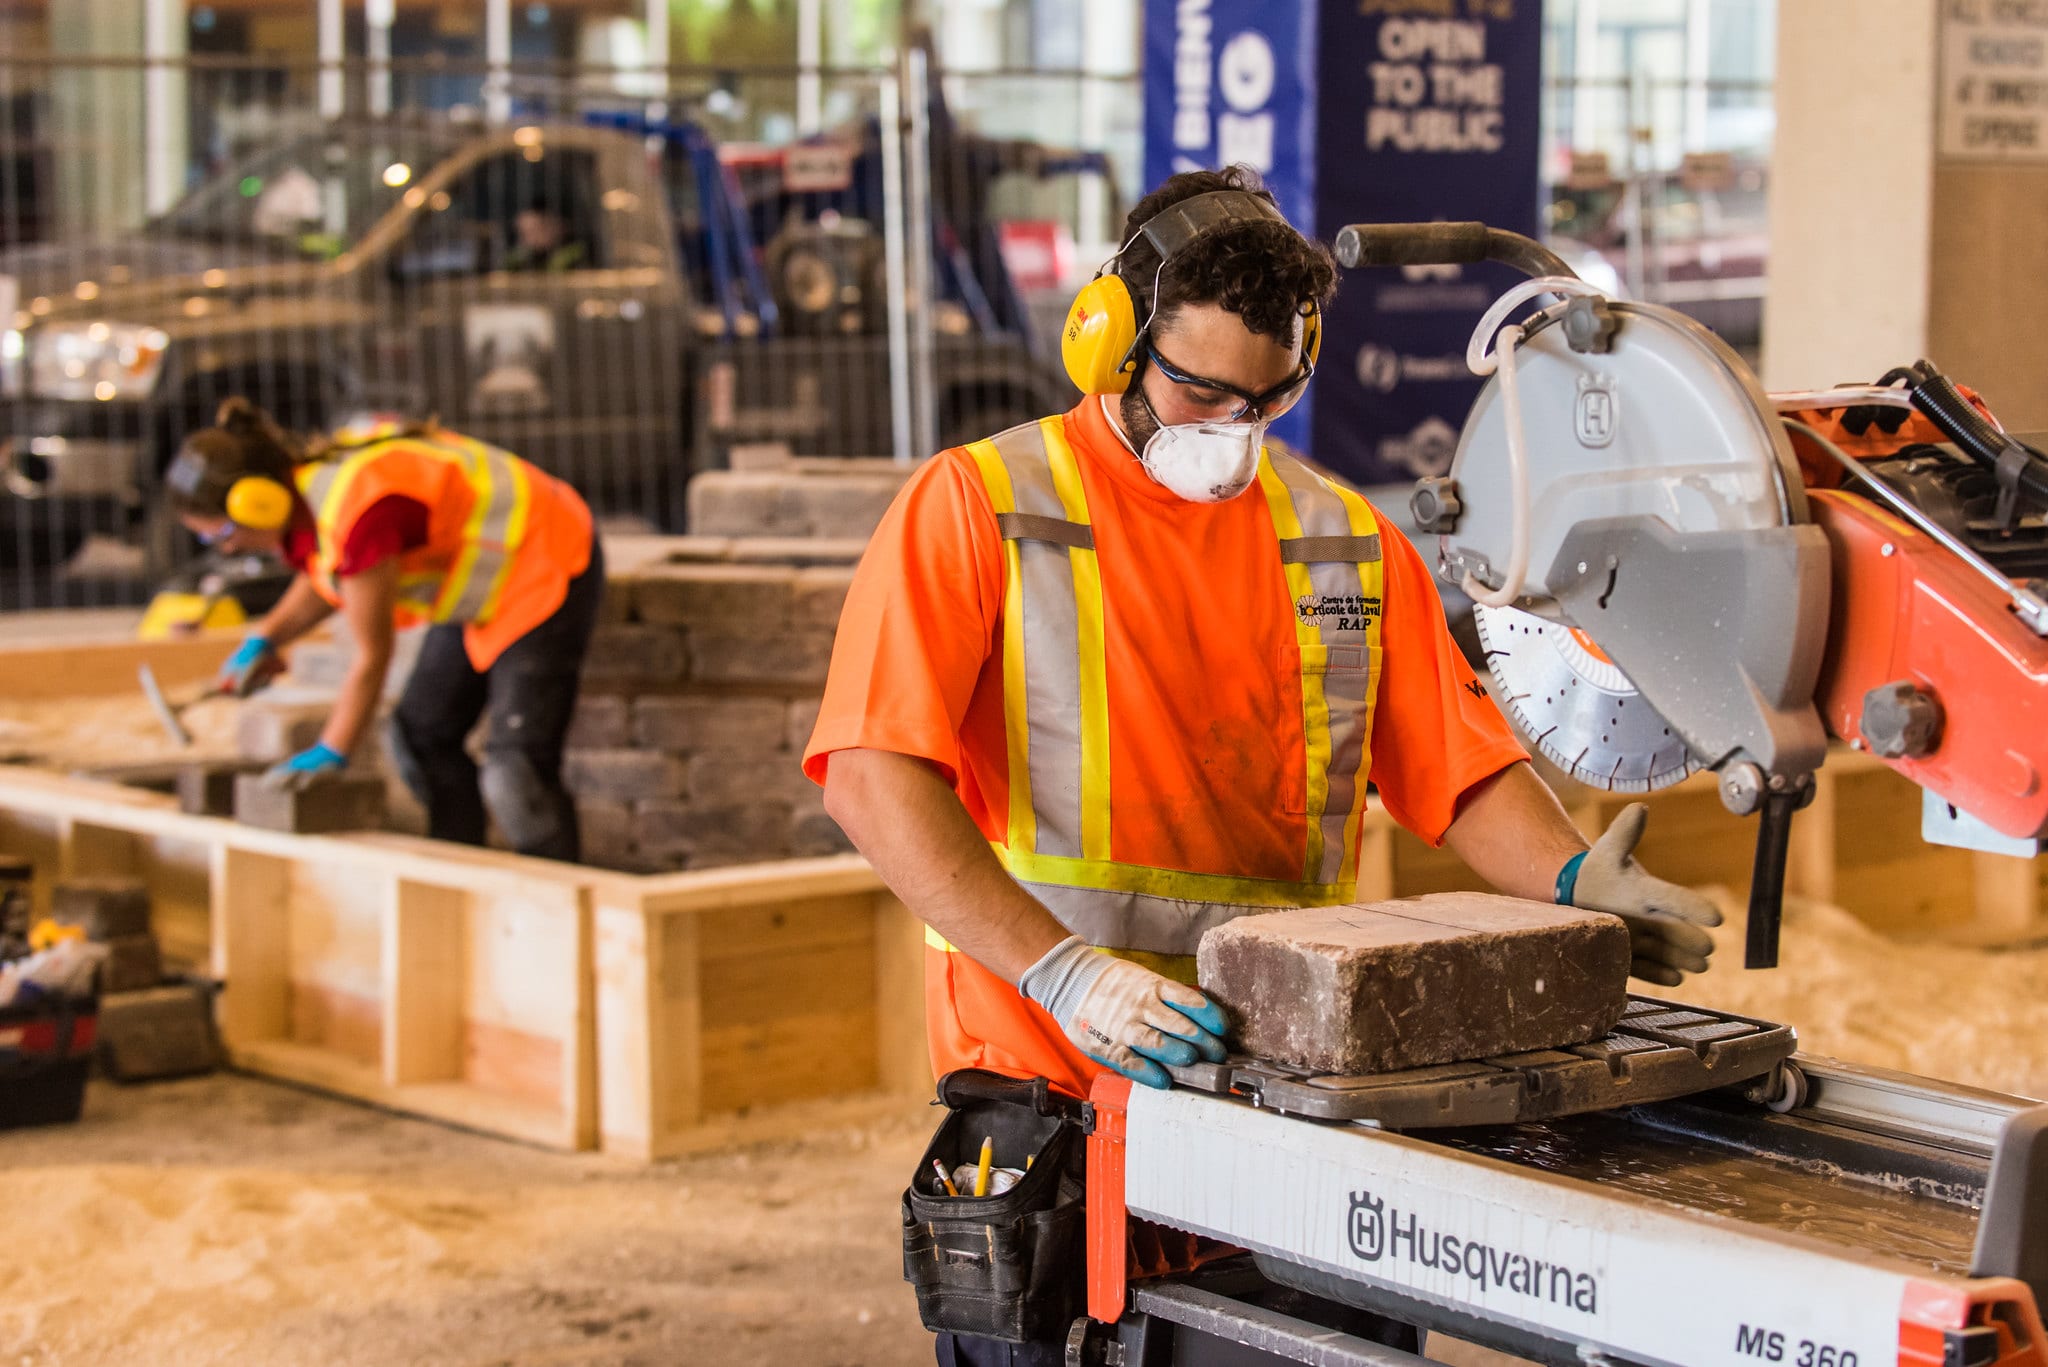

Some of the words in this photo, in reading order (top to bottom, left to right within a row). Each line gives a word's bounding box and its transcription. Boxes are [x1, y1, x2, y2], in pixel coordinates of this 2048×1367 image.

[1378, 18, 1486, 61] OPEN
[1369, 62, 1425, 106] TO
[1429, 63, 1503, 106] THE
[1366, 107, 1503, 152] PUBLIC
[1077, 306, 1088, 324] 3M
[1322, 596, 1344, 604] Centre
[1345, 596, 1353, 604] de
[1347, 604, 1359, 615] de
[1360, 604, 1380, 616] Laval
[1337, 617, 1371, 631] RAP
[1390, 1208, 1597, 1314] Husqvarna
[1736, 1323, 1785, 1361] MS
[1797, 1339, 1858, 1367] 360
